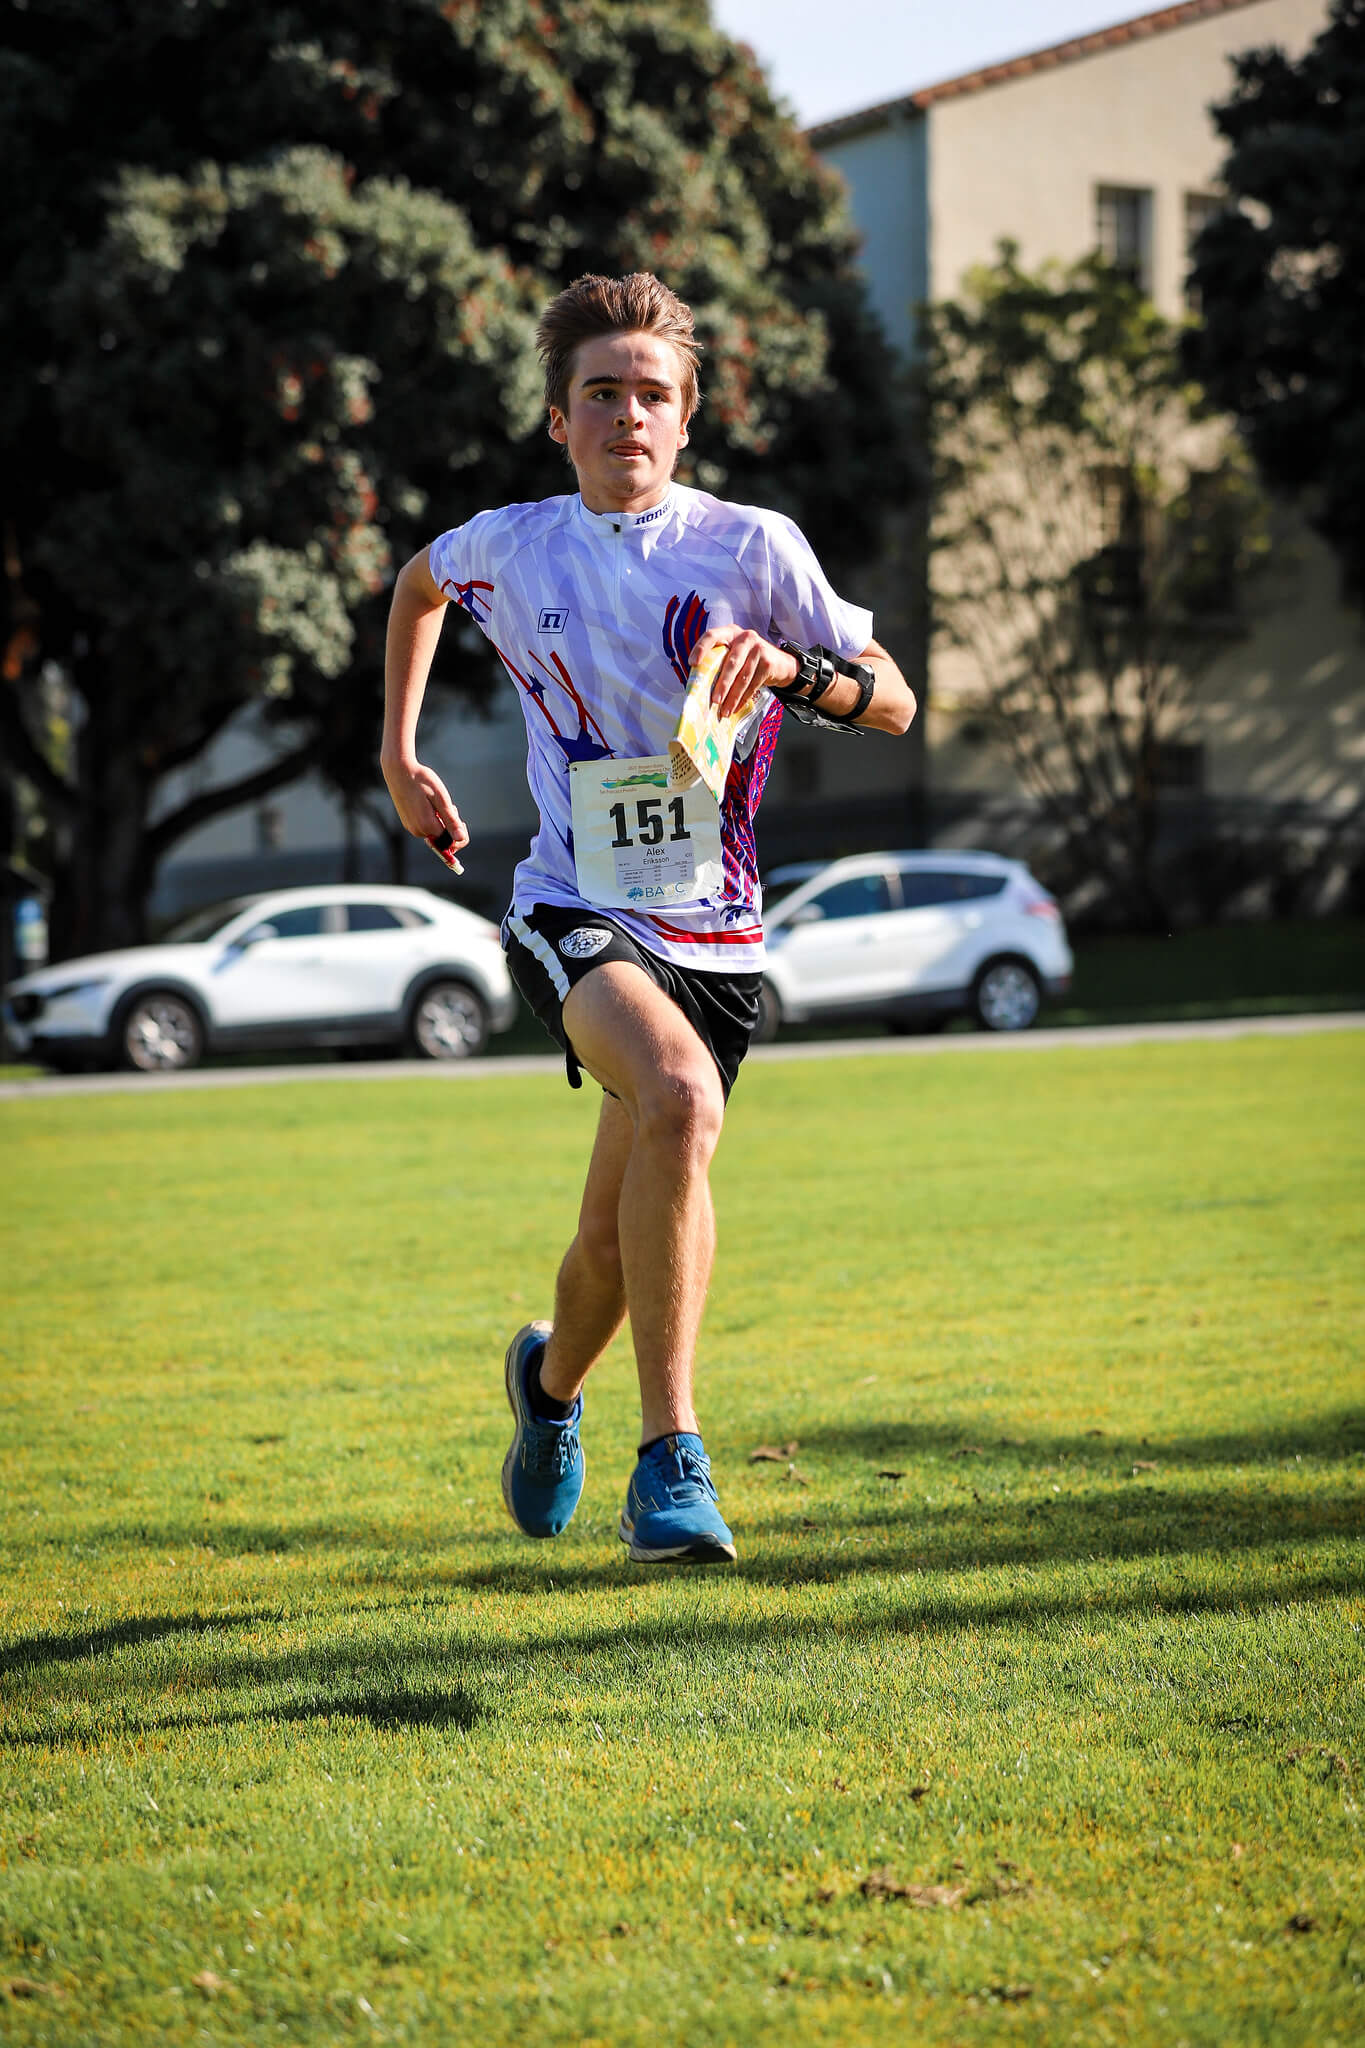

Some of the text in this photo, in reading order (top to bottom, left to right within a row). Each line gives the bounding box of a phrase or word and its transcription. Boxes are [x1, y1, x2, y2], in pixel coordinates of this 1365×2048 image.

[610, 797, 691, 848] 151
[646, 847, 666, 857] Alex
[643, 856, 670, 865] Eriksson
[645, 882, 686, 898] BAC
